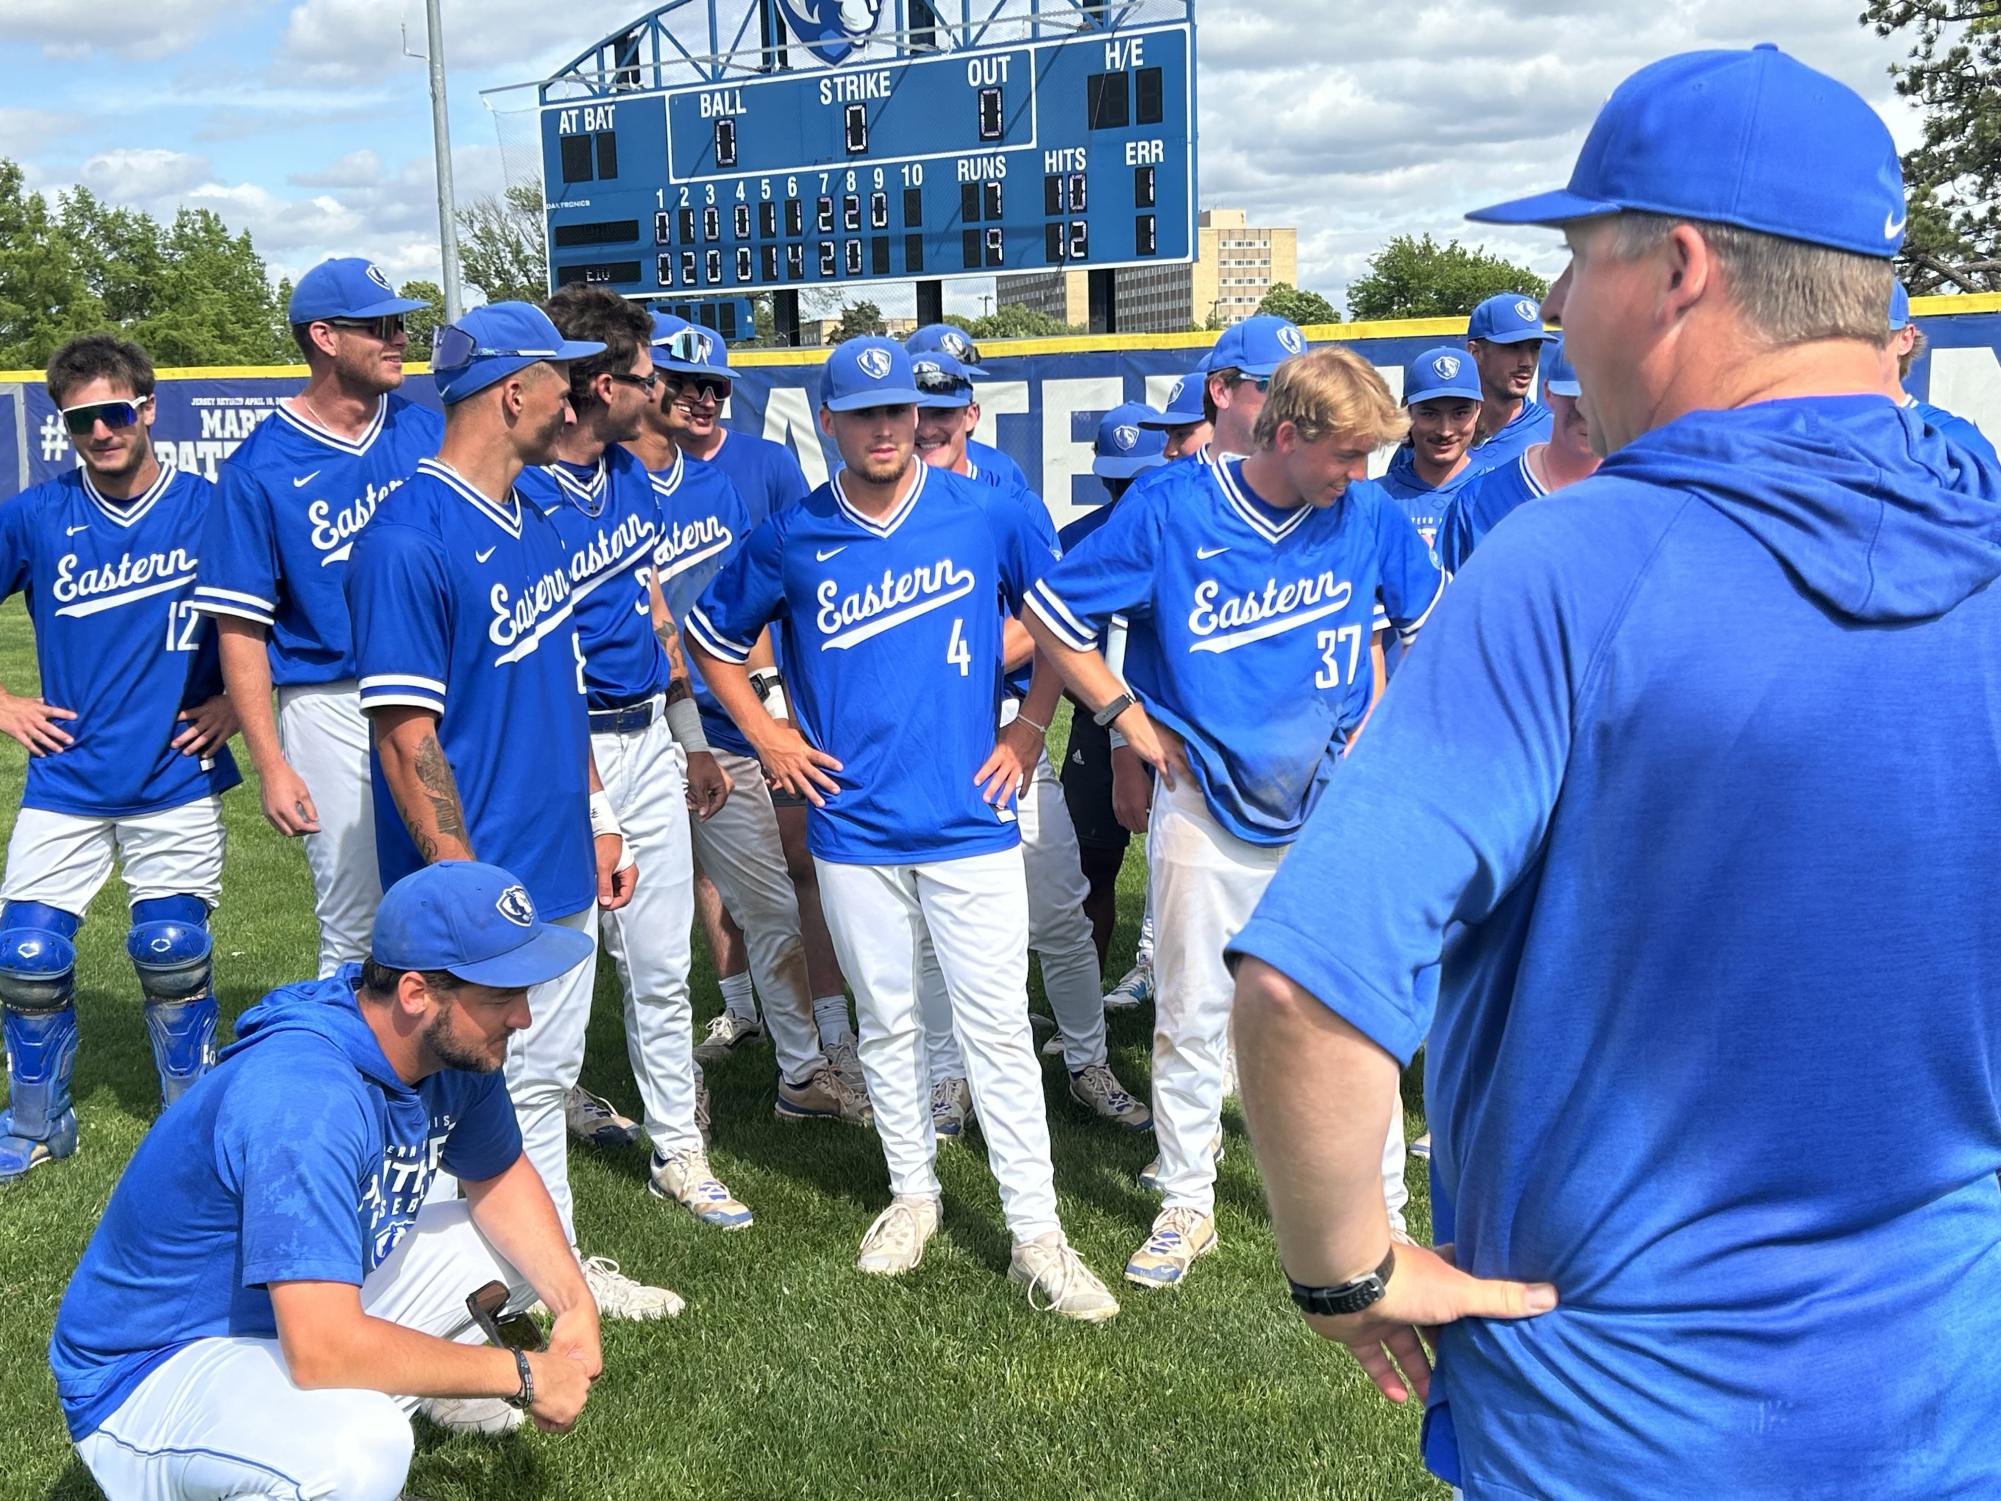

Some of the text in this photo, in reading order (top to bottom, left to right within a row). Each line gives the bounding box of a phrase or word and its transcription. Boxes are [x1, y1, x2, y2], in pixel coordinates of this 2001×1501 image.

[967, 56, 1011, 86] OUT
[1105, 38, 1143, 71] H/E
[701, 90, 747, 118] BALL
[820, 71, 891, 105] STRIKE
[559, 105, 615, 134] AT BAT
[847, 105, 866, 150] 0
[980, 88, 1001, 137] 0
[716, 120, 735, 164] 0
[1045, 148, 1086, 173] HITS
[1125, 140, 1164, 165] ERR
[656, 164, 923, 208] 1 2 3 4 5 6 7 8 9 10
[957, 156, 1006, 181] RUNS
[191, 397, 215, 406] JERSEY
[245, 397, 265, 406] APRIL
[570, 513, 655, 582] astern
[53, 548, 198, 604] Eastern
[816, 559, 975, 636] Eastern
[1188, 570, 1351, 637] Eastern
[165, 601, 199, 652] 12
[946, 618, 972, 677] 4
[1314, 624, 1362, 690] 37
